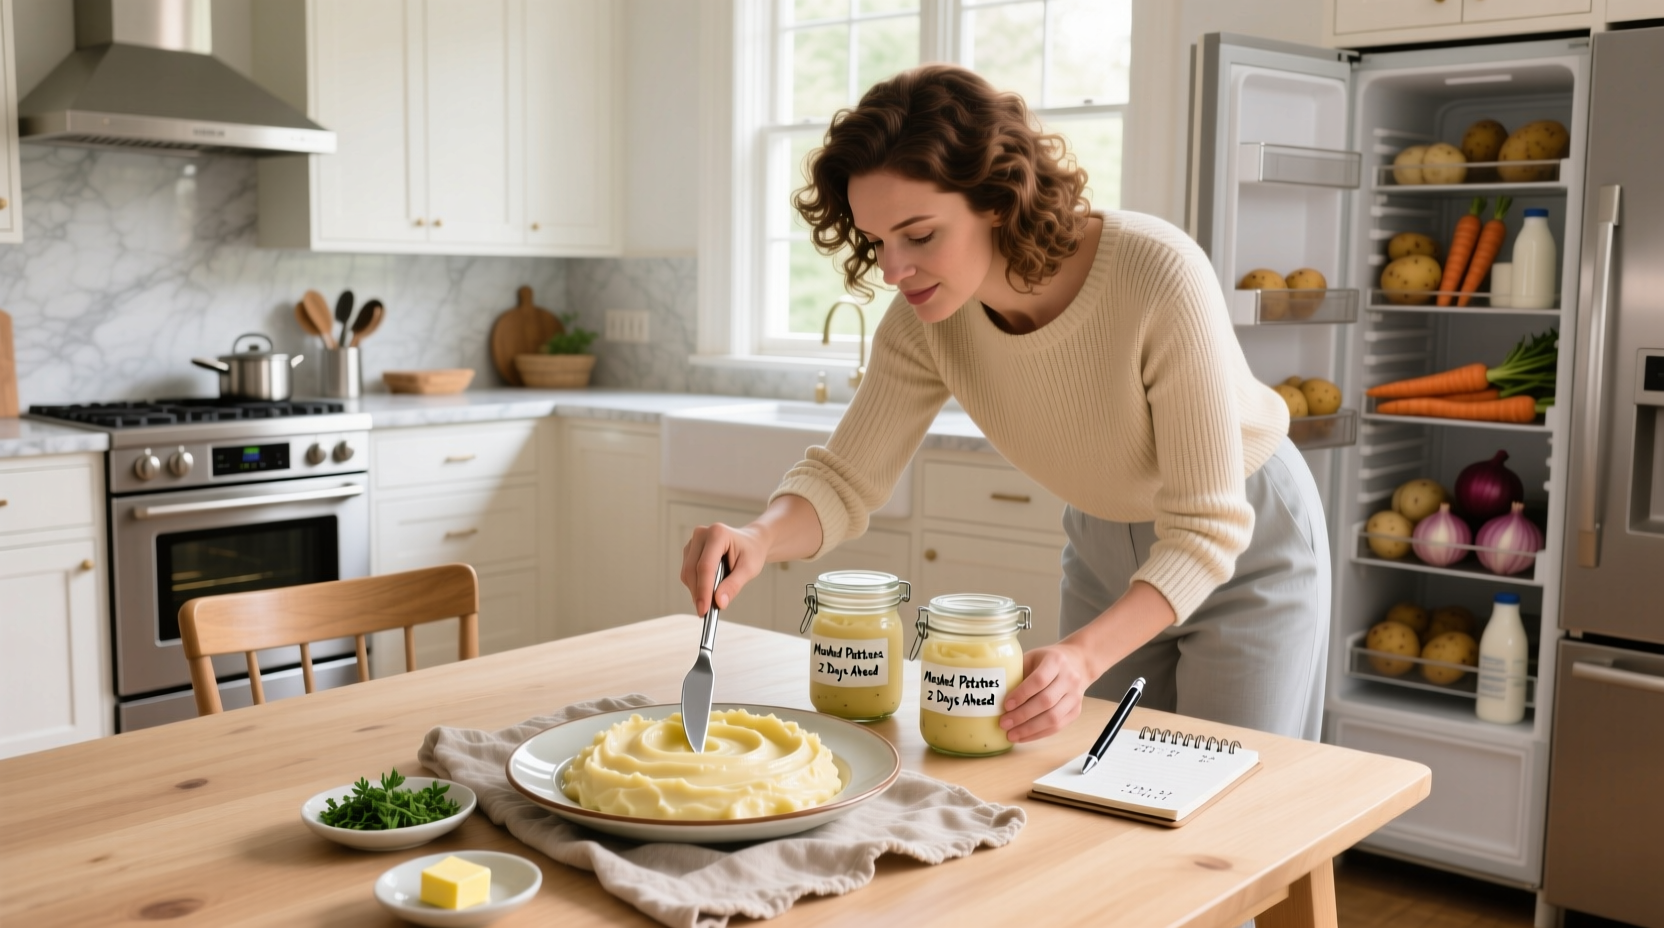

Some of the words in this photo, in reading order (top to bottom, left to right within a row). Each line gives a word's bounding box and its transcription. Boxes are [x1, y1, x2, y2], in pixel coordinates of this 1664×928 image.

[818, 662, 825, 673] 2
[927, 690, 934, 701] 2
[936, 689, 960, 712] Days
[962, 693, 995, 706] Ahead
